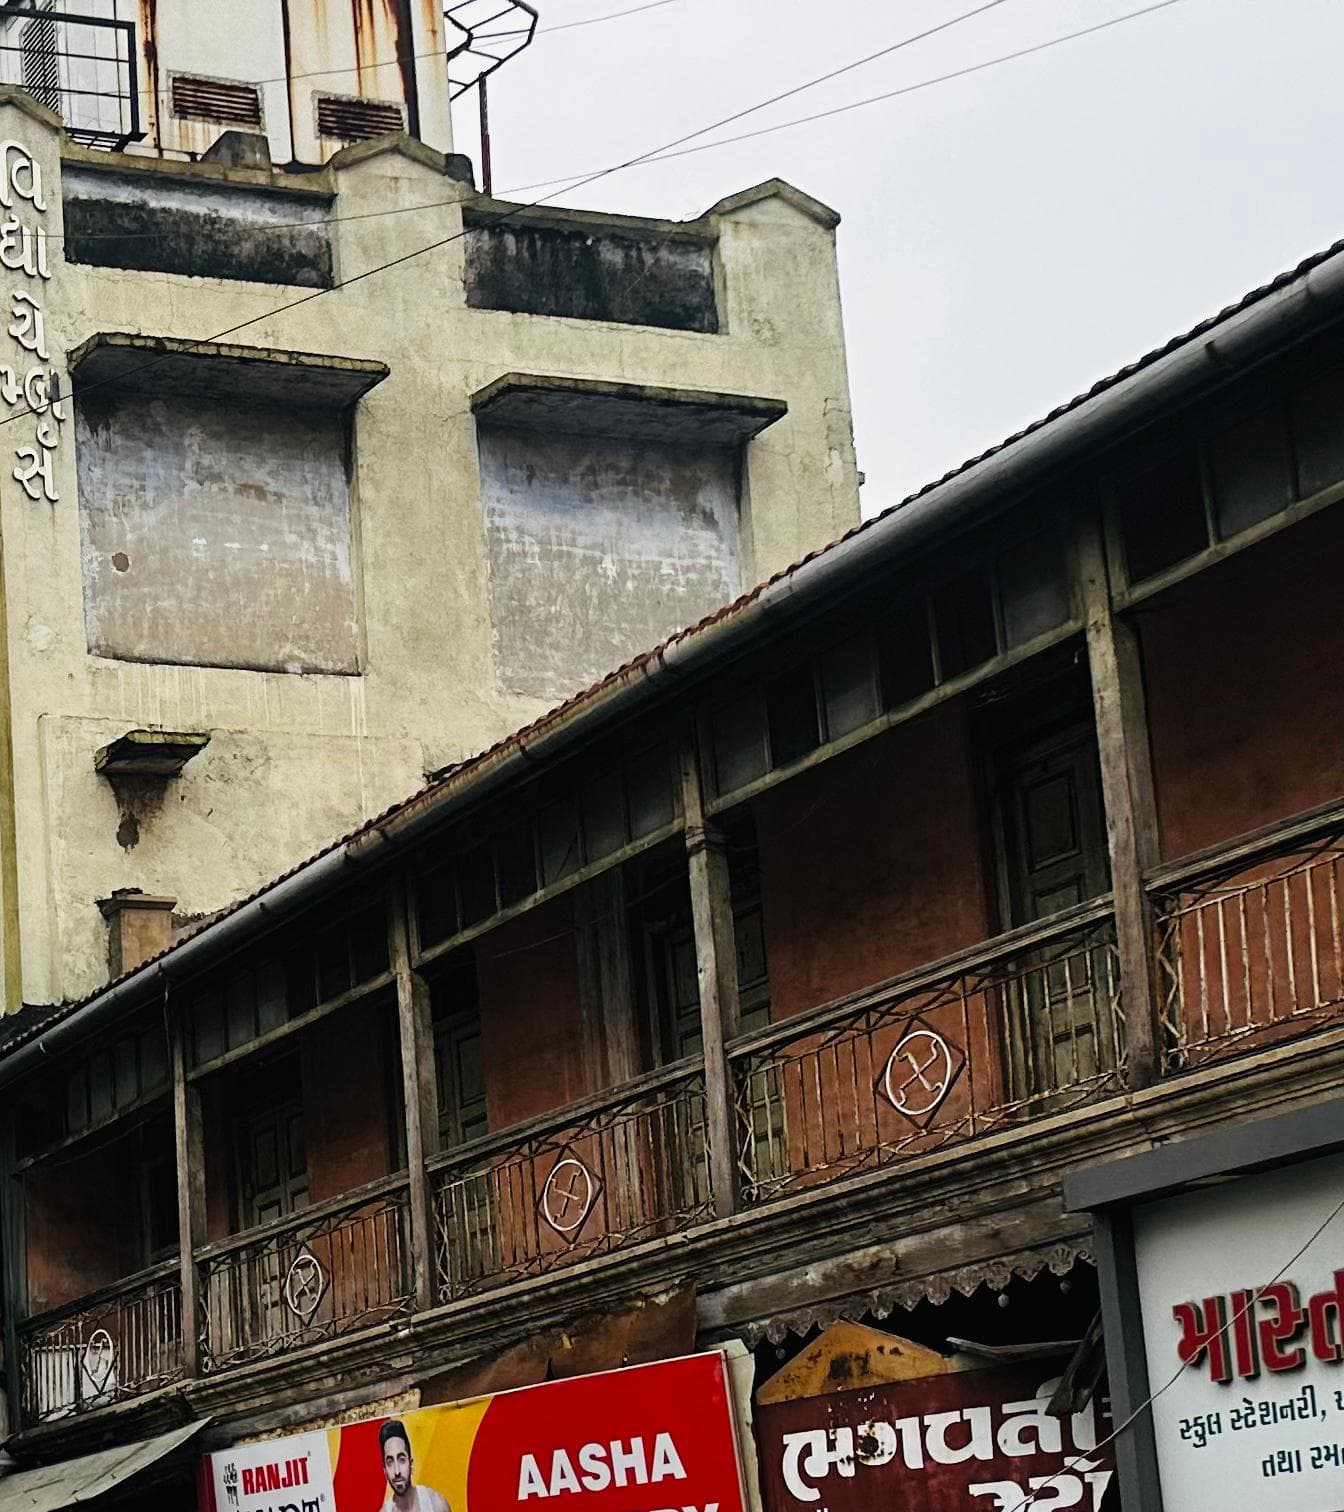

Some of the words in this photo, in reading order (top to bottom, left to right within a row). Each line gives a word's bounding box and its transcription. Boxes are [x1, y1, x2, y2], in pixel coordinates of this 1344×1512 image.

[241, 1457, 310, 1496] RANJIT
[517, 1432, 688, 1501] AASHA
[1262, 1449, 1302, 1478] તથા
